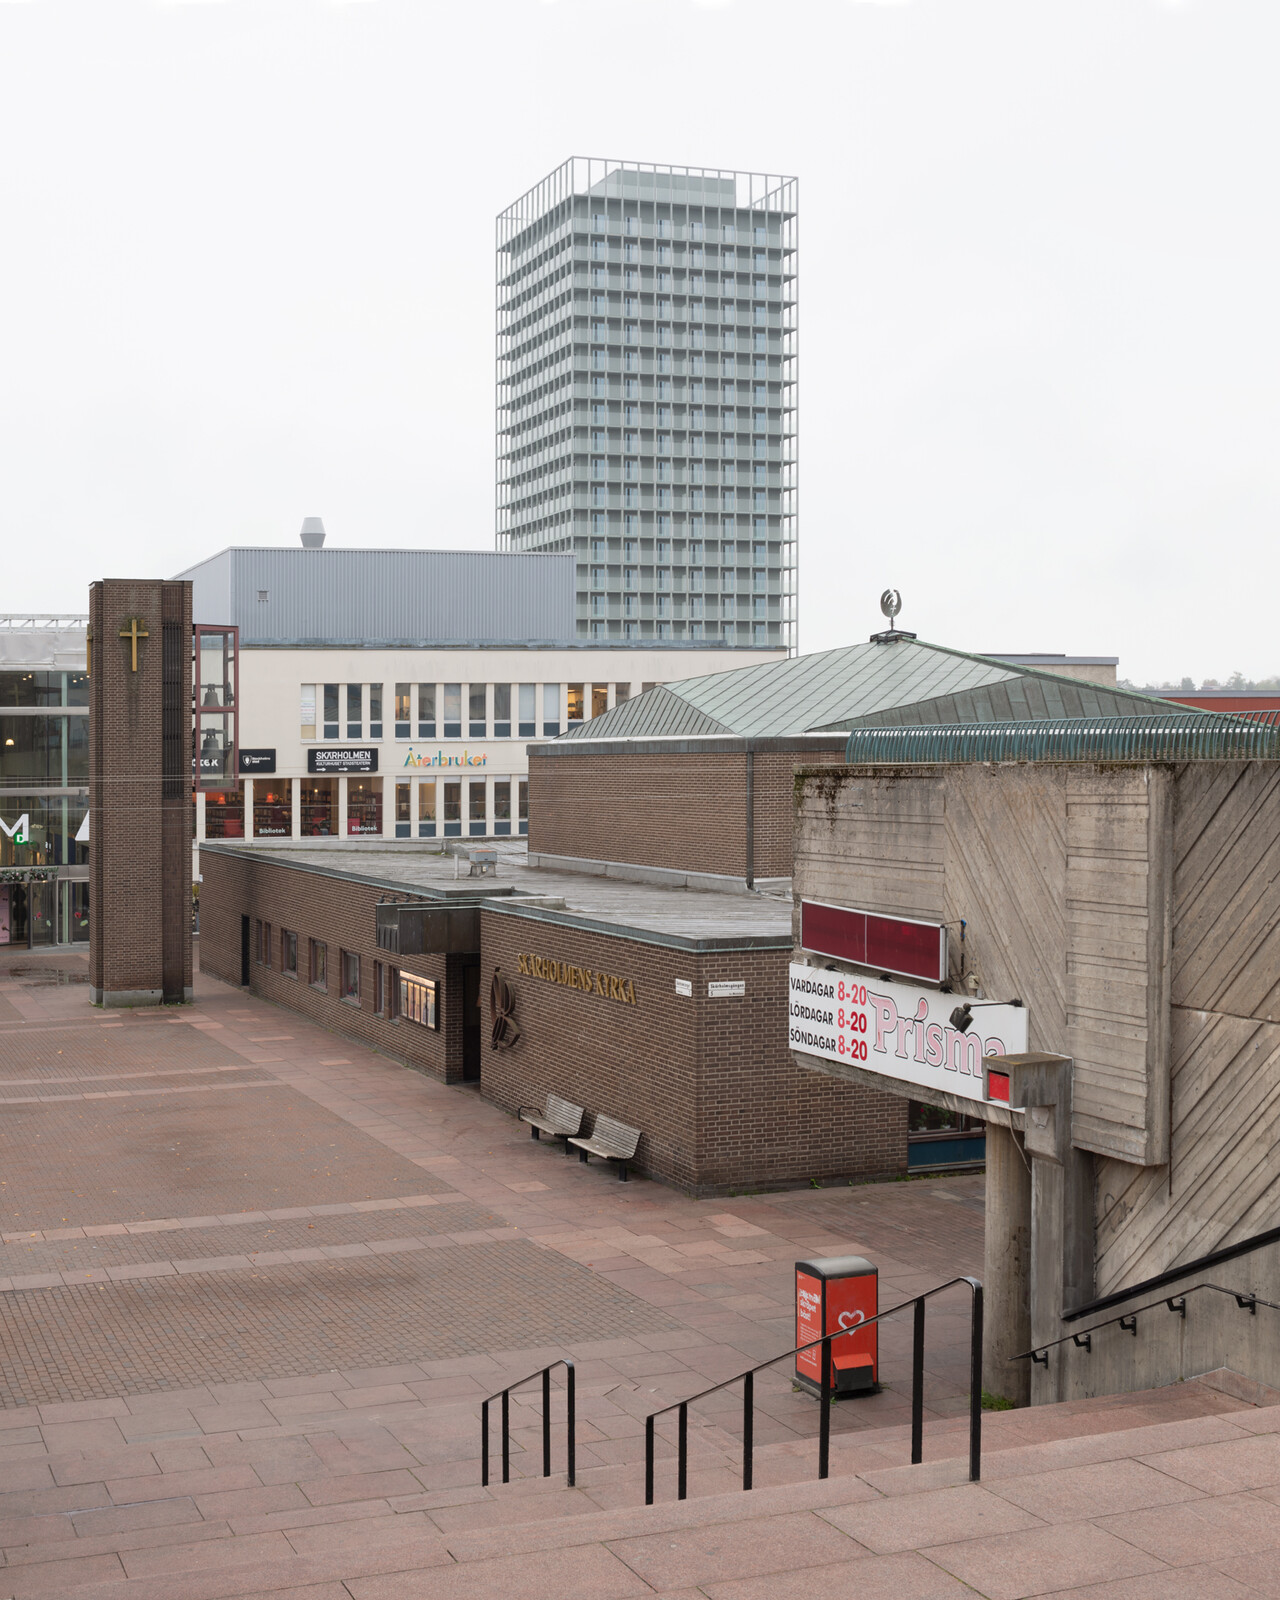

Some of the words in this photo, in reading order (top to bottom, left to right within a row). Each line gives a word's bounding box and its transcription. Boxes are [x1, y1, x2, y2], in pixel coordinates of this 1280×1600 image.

[316, 751, 371, 760] SKÄRHOLMEN
[404, 747, 487, 767] Återbruket
[518, 953, 593, 992] SKÄRHOLMENS
[595, 972, 636, 1005] KYRKA
[790, 977, 835, 999] VARDAGAR
[837, 980, 867, 1006] 8-20
[790, 1001, 834, 1026] LÖRDAGAR
[837, 1008, 867, 1034] 8-20
[790, 1026, 836, 1053] SÖNDAGAR
[838, 1034, 868, 1061] 8-20
